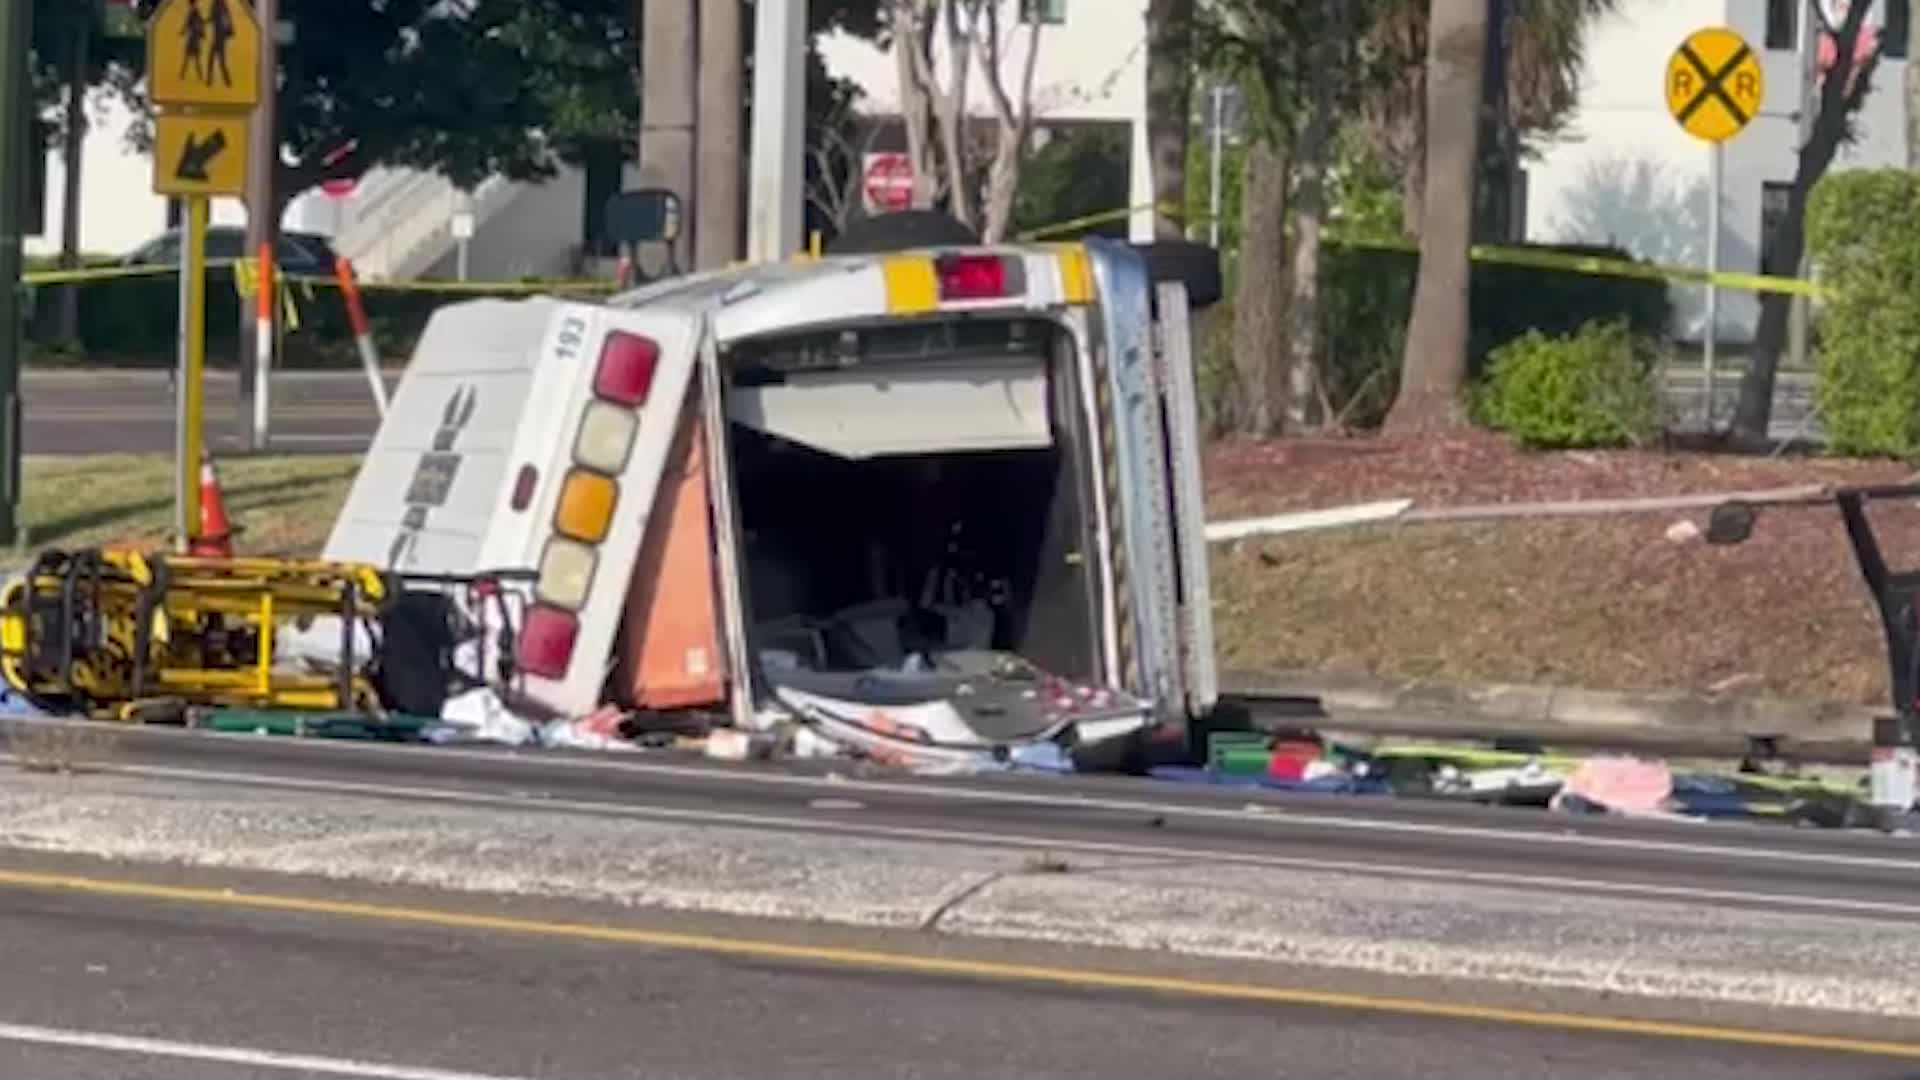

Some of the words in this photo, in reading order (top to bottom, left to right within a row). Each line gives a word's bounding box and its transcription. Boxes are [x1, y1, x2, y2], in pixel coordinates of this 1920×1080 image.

[1673, 69, 1692, 98] R
[1735, 70, 1755, 98] R
[555, 317, 585, 359] 193
